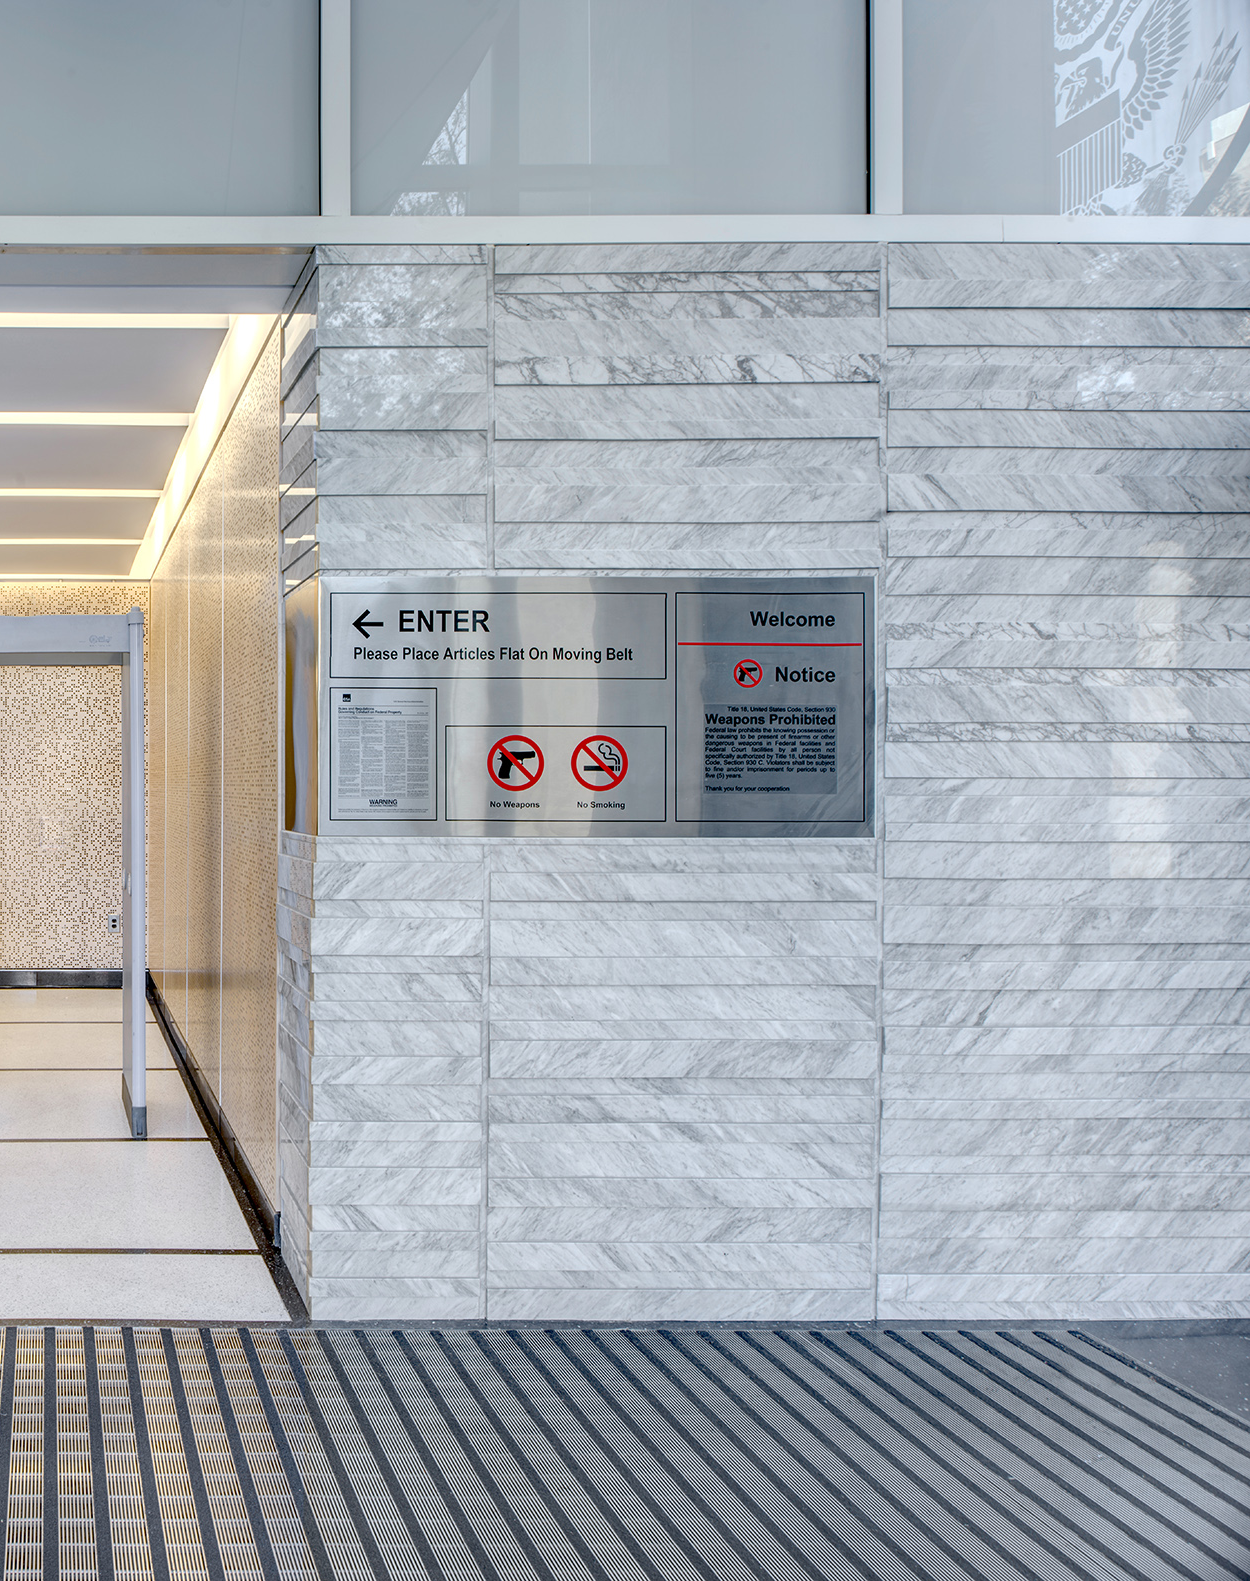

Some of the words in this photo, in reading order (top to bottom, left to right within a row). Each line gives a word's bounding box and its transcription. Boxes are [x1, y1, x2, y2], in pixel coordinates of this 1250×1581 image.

[399, 610, 490, 632] ENTER
[750, 611, 836, 627] Welcome
[353, 647, 398, 660] Please
[402, 647, 439, 660] Place
[443, 647, 495, 660] Articles
[500, 647, 525, 660] Flat
[528, 647, 548, 660] On
[552, 647, 602, 664] Moving
[606, 648, 633, 660] Belt
[776, 666, 836, 682] Notice
[705, 714, 765, 726] Weapons
[770, 714, 835, 725] Prohibited
[503, 801, 540, 809] Weapons
[590, 801, 626, 810] Smoking
